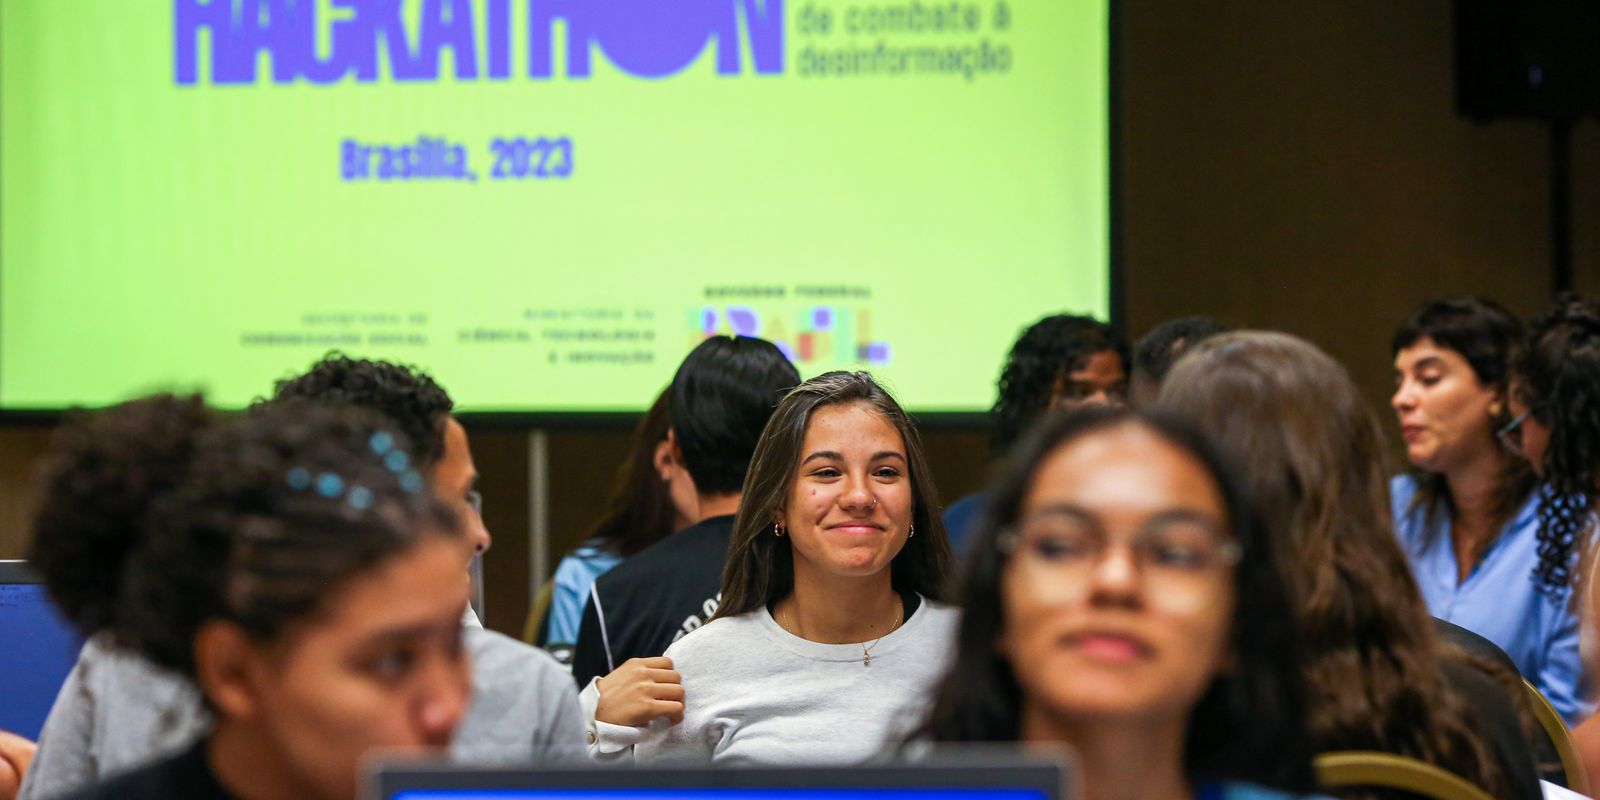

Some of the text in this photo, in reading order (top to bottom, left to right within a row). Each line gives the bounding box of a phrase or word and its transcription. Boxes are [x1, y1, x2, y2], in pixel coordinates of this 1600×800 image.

[846, 0, 980, 33] combate
[174, 0, 785, 84] HACKATHON
[797, 40, 1012, 81] desinformação
[490, 136, 574, 180] 2023
